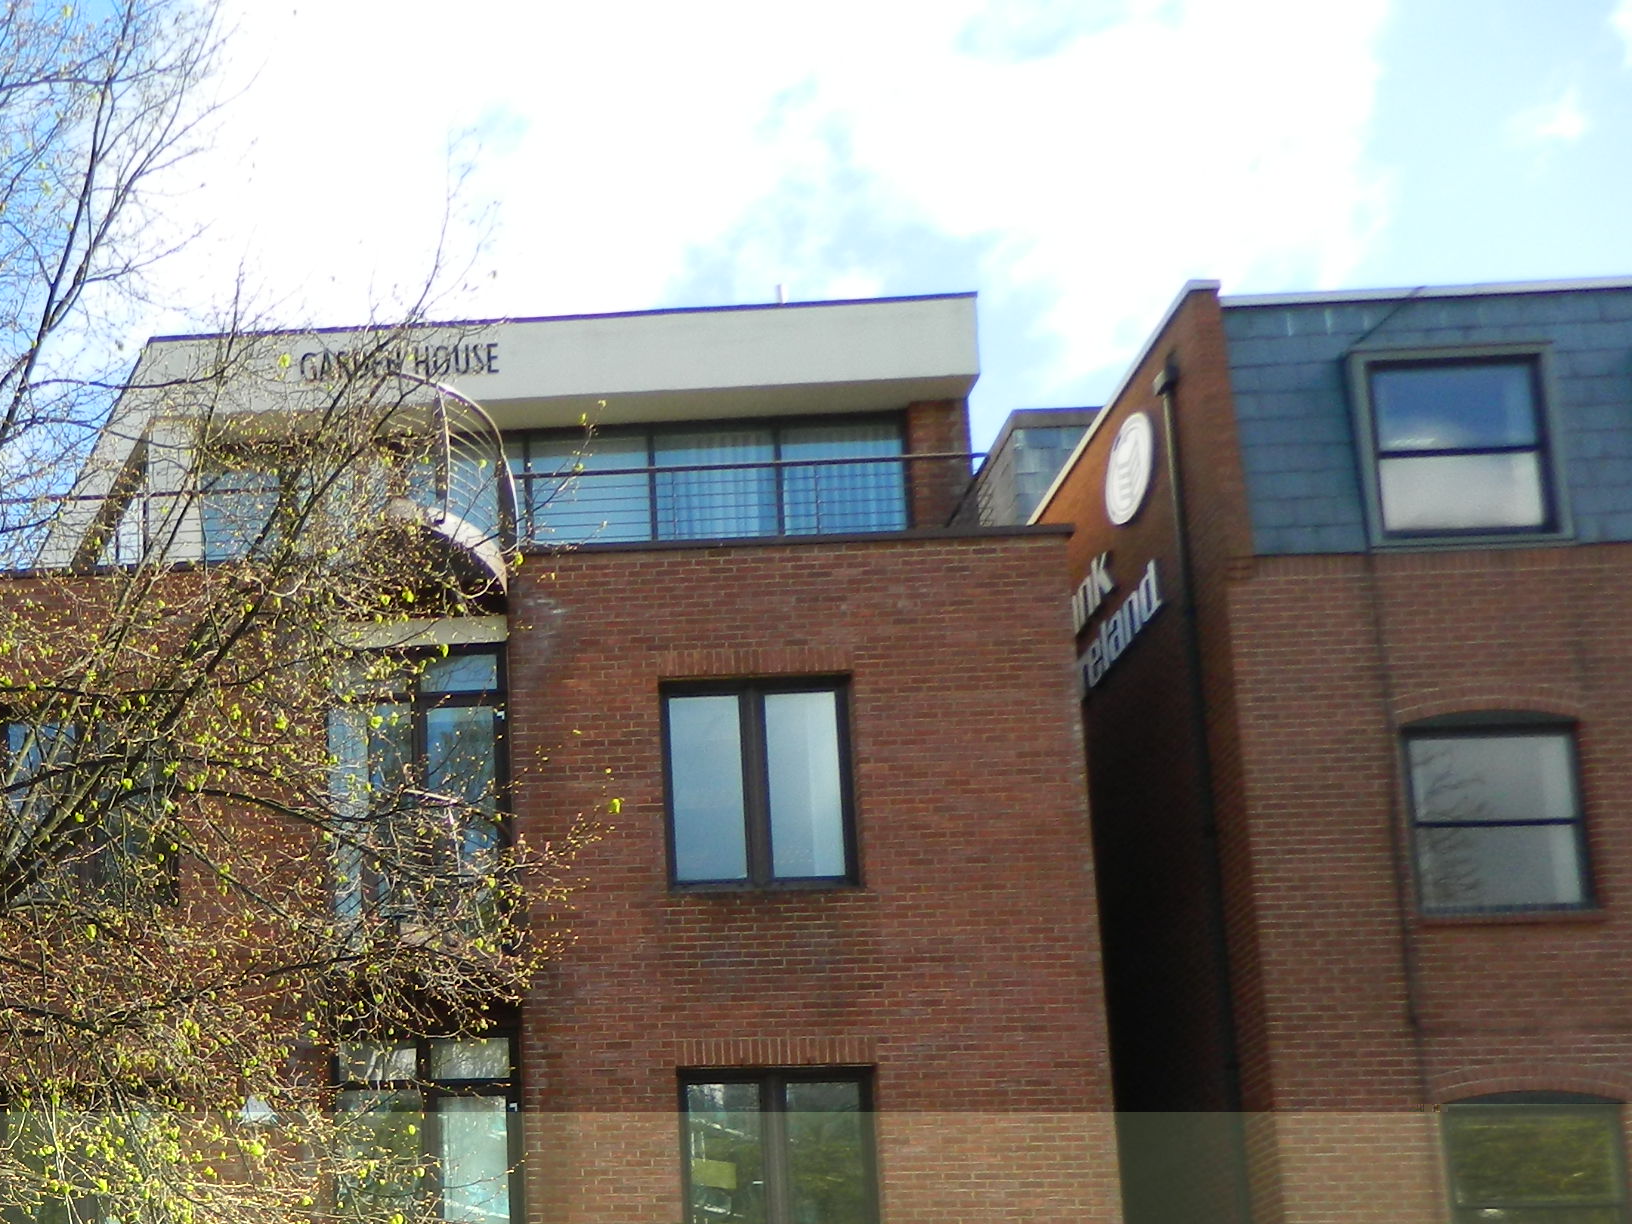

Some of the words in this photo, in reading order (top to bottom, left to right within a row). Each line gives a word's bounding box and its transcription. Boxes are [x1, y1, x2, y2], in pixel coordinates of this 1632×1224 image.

[414, 343, 499, 377] HOUSE
[1072, 552, 1114, 634] nk
[1077, 559, 1162, 690] reland
